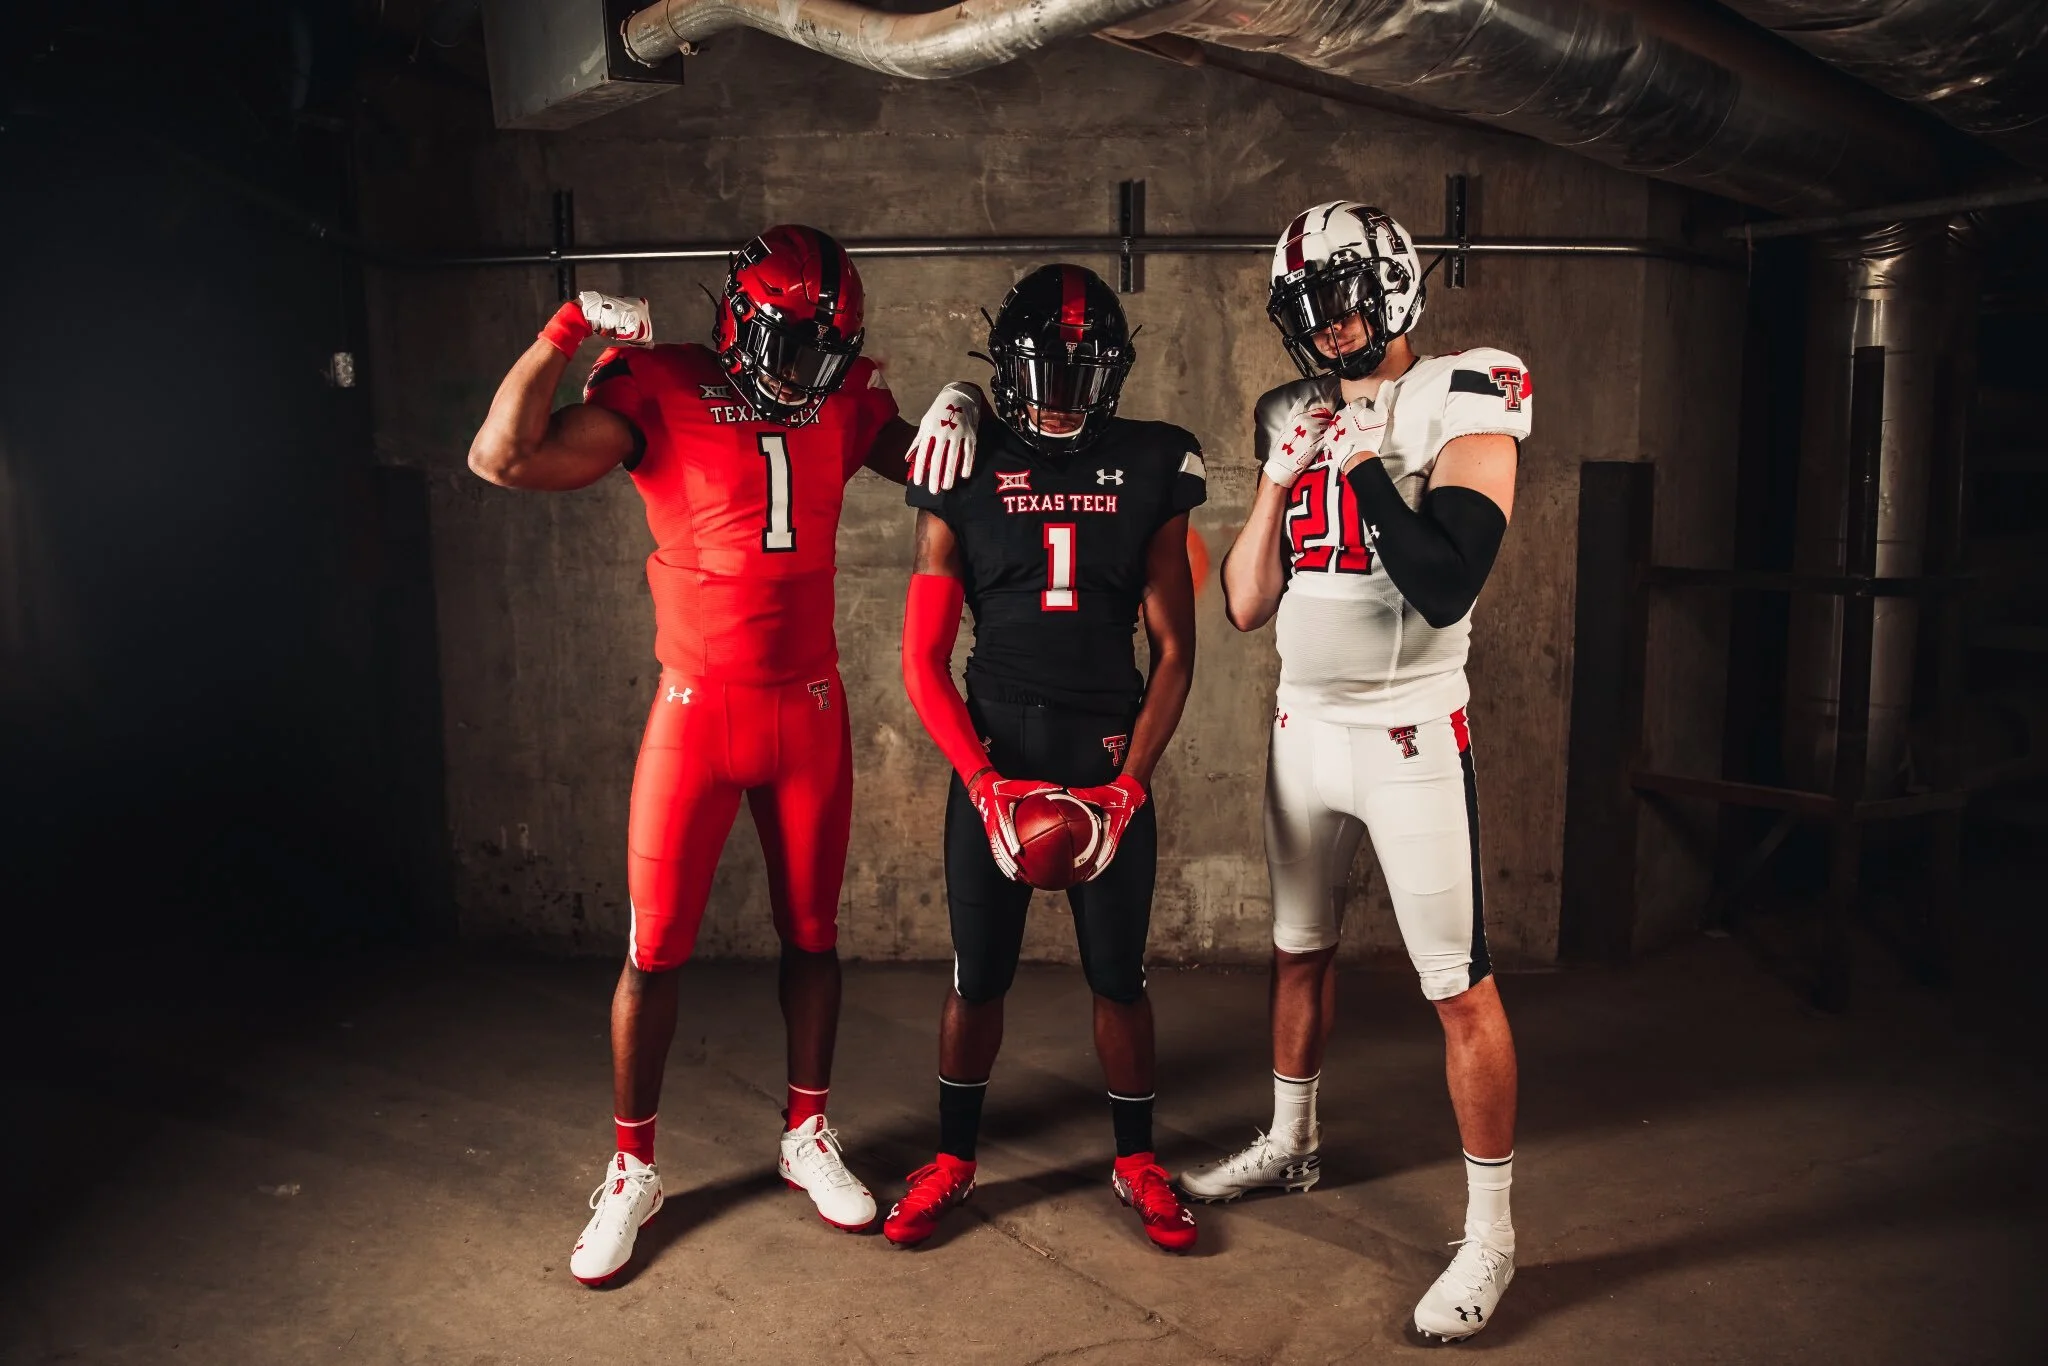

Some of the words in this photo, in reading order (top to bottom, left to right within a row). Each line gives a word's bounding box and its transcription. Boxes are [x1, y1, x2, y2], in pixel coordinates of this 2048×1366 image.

[710, 405, 762, 423] TEXA
[757, 432, 797, 553] 1
[1003, 493, 1066, 514] TEXAS
[1069, 493, 1119, 513] TECH
[1287, 464, 1375, 576] 21
[1041, 523, 1078, 611] 1
